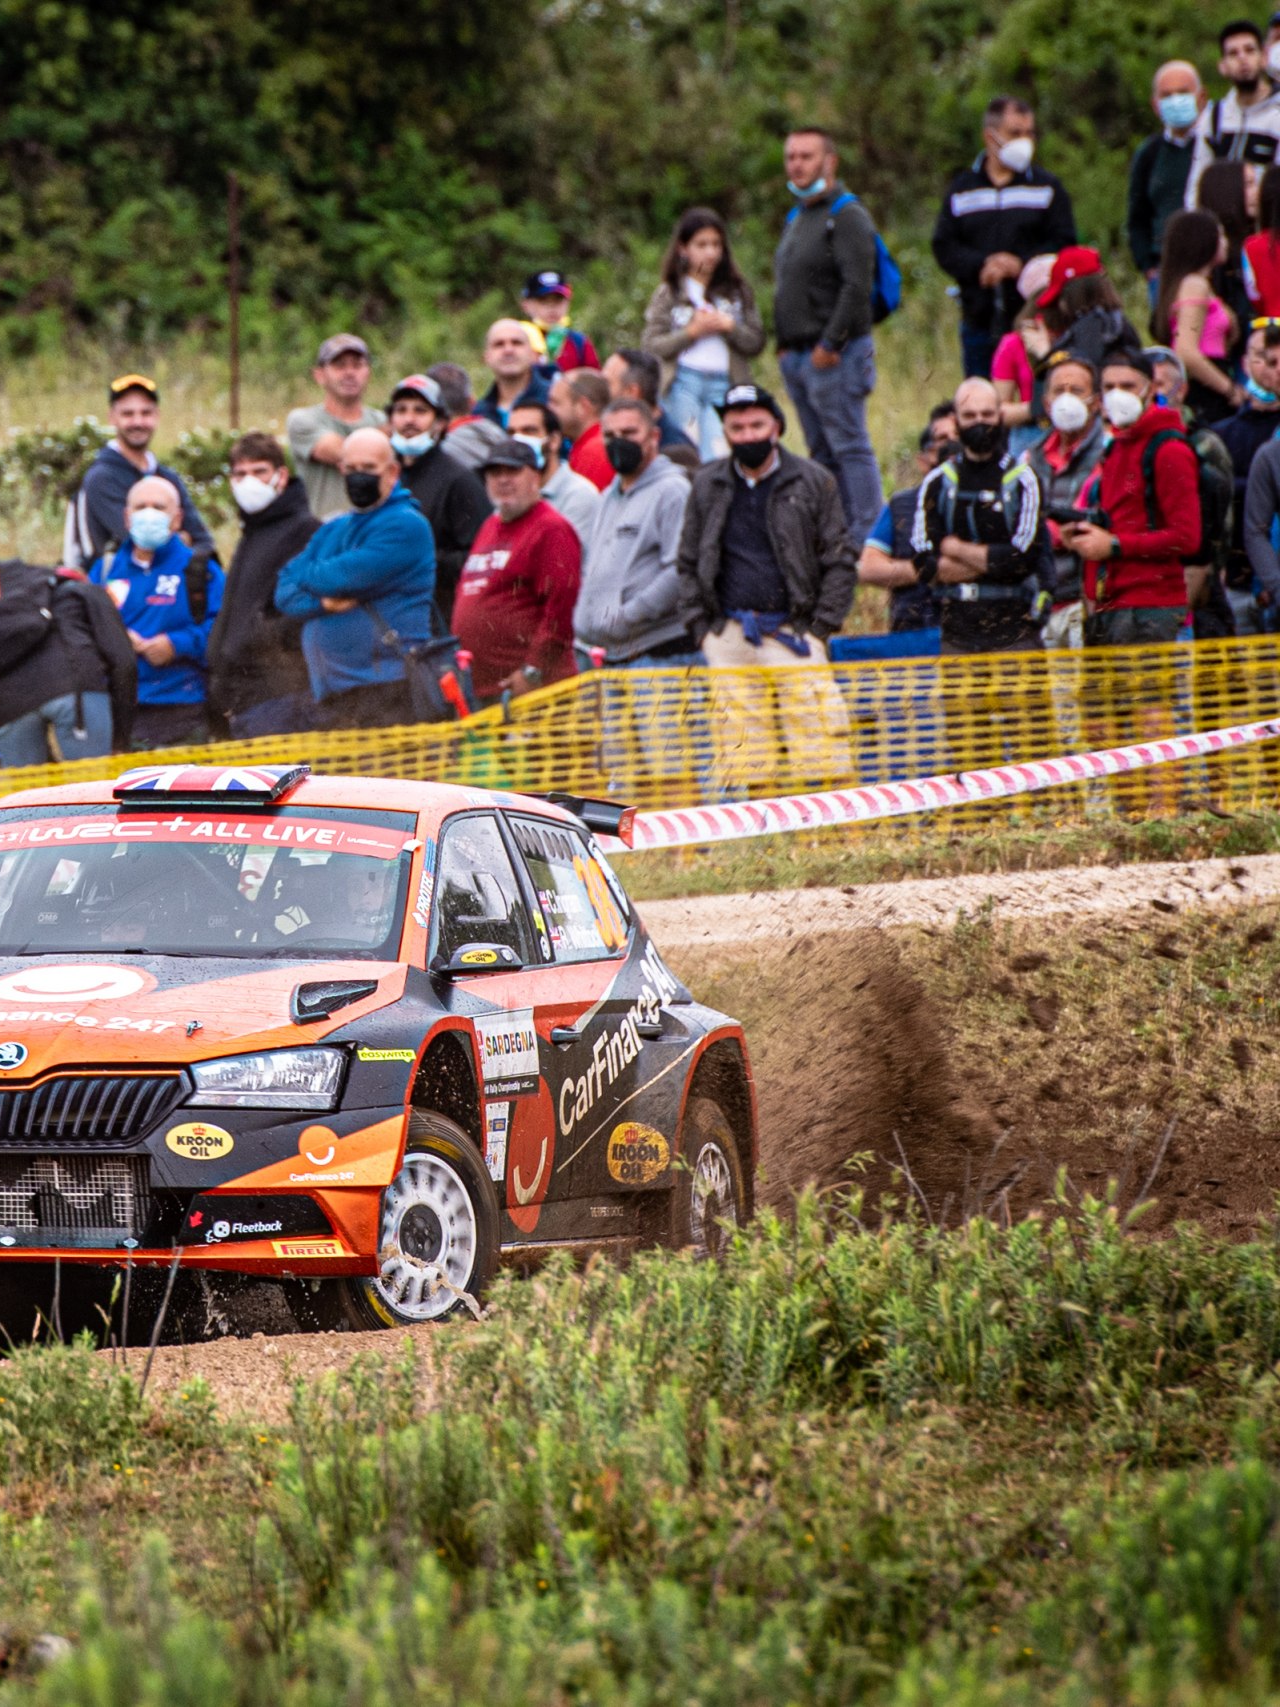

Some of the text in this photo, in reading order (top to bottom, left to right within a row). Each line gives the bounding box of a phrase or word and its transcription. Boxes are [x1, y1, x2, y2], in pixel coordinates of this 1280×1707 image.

[190, 822, 252, 839] ALL
[262, 825, 336, 845] LIVE
[103, 1016, 177, 1034] 247
[485, 1030, 536, 1057] SARDEGNA
[559, 985, 661, 1136] CarFinance
[176, 1135, 223, 1148] KROON
[190, 1146, 210, 1157] OIL
[612, 1143, 661, 1162] KROON
[289, 1171, 355, 1182] CarFinance 247
[232, 1220, 283, 1234] Fleetback
[280, 1242, 337, 1256] PIRELLI
